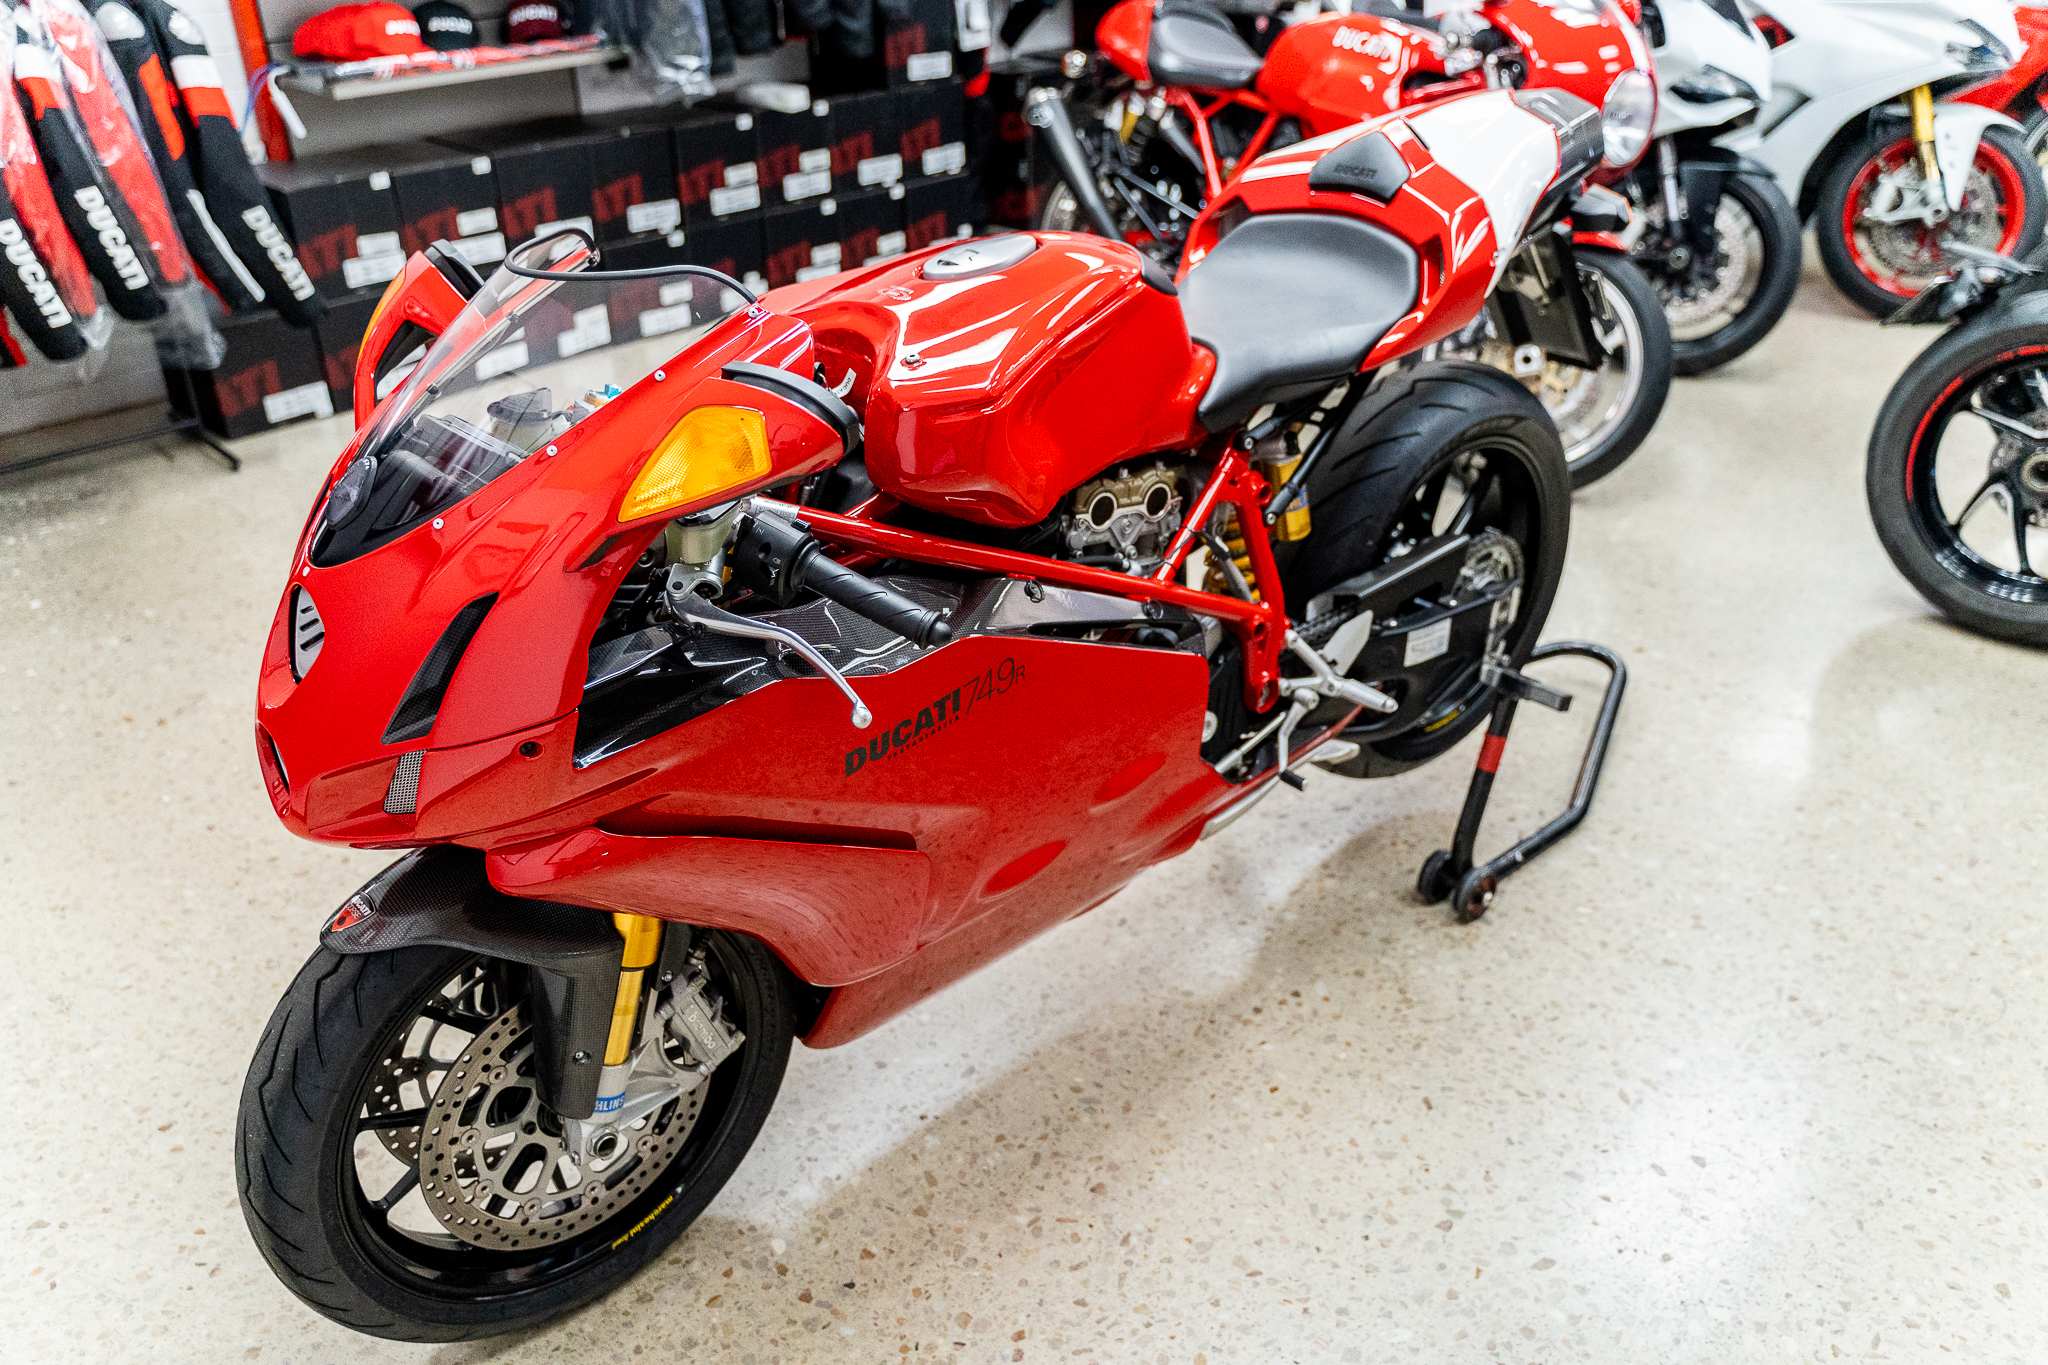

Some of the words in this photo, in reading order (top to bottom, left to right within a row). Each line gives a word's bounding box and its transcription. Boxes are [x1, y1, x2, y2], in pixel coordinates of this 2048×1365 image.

[1333, 163, 1378, 180] DUCATI
[0, 218, 73, 328] DUCATI
[73, 185, 150, 290] DUCATI
[241, 204, 316, 301] DUCATI
[845, 687, 961, 777] DUCATI
[688, 1011, 716, 1049] brembo
[595, 1095, 625, 1111] HLINS
